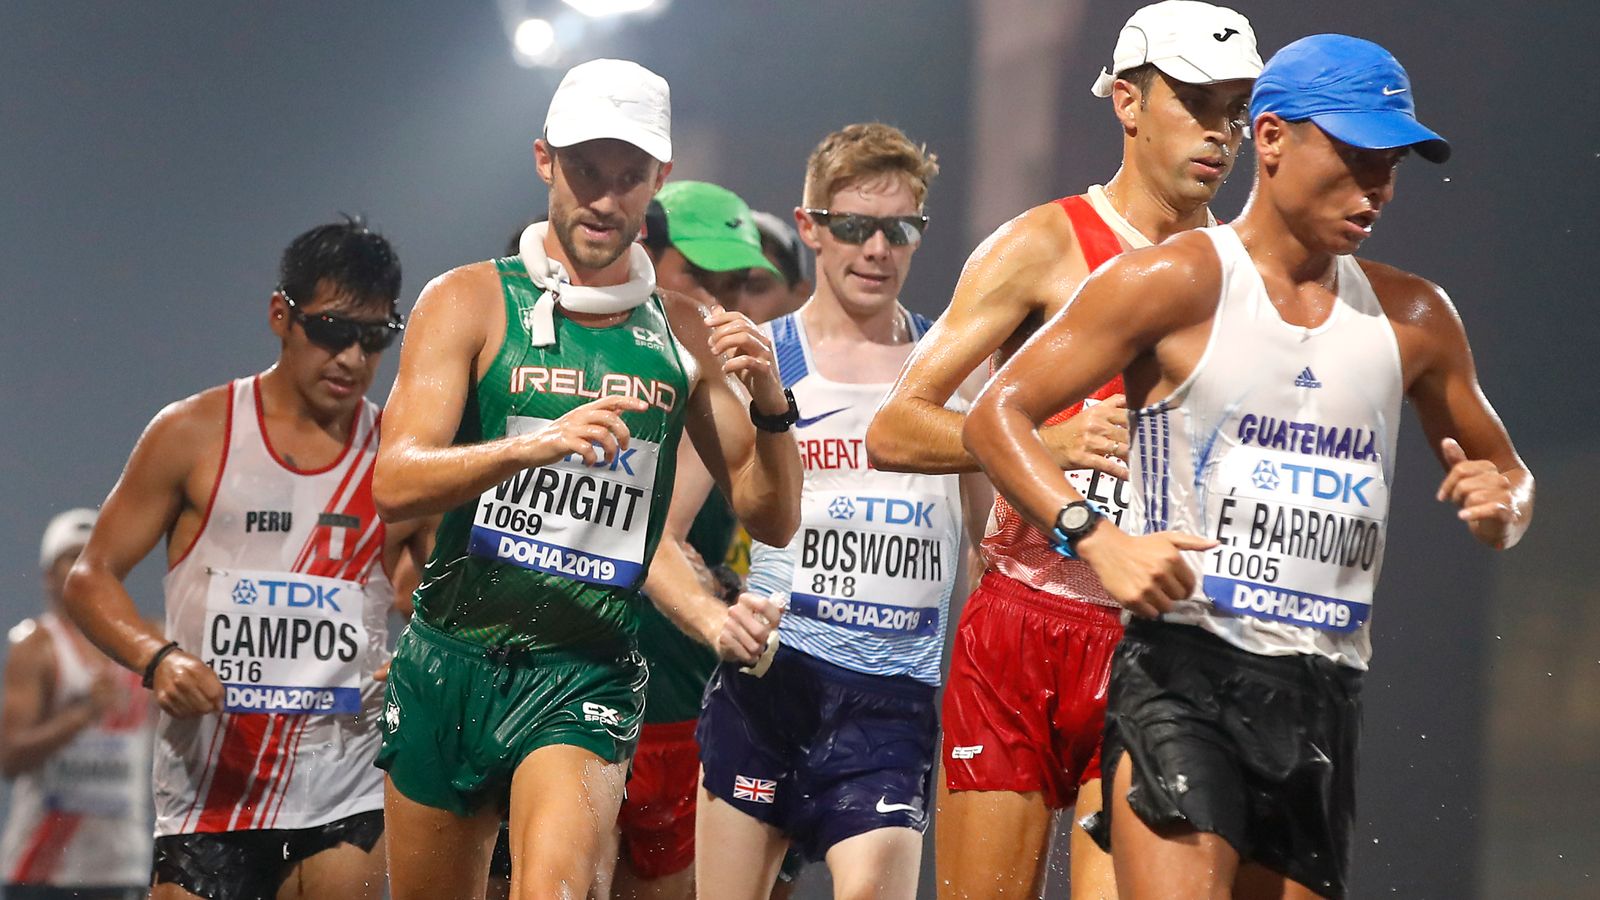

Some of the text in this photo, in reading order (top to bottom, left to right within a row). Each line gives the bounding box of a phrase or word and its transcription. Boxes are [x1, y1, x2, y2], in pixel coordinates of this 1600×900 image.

[510, 366, 677, 413] IRELAND
[1238, 413, 1378, 463] GUATEMALA
[495, 467, 644, 531] WRIGHT
[1281, 462, 1375, 507] TDK
[246, 511, 292, 533] PERU
[483, 502, 543, 536] 1069
[856, 496, 938, 529] TDK
[1216, 487, 1379, 572] É. BARRONDO
[498, 536, 615, 581] DOHA2019
[801, 528, 942, 582] BOSWORTH
[1212, 551, 1280, 583] 1005
[258, 580, 341, 612] TDK
[811, 573, 856, 598] 818
[1232, 583, 1350, 627] DOHA2019
[817, 599, 921, 630] DOHA2019
[211, 614, 358, 662] CAMPOS
[226, 688, 335, 710] DOHA2019
